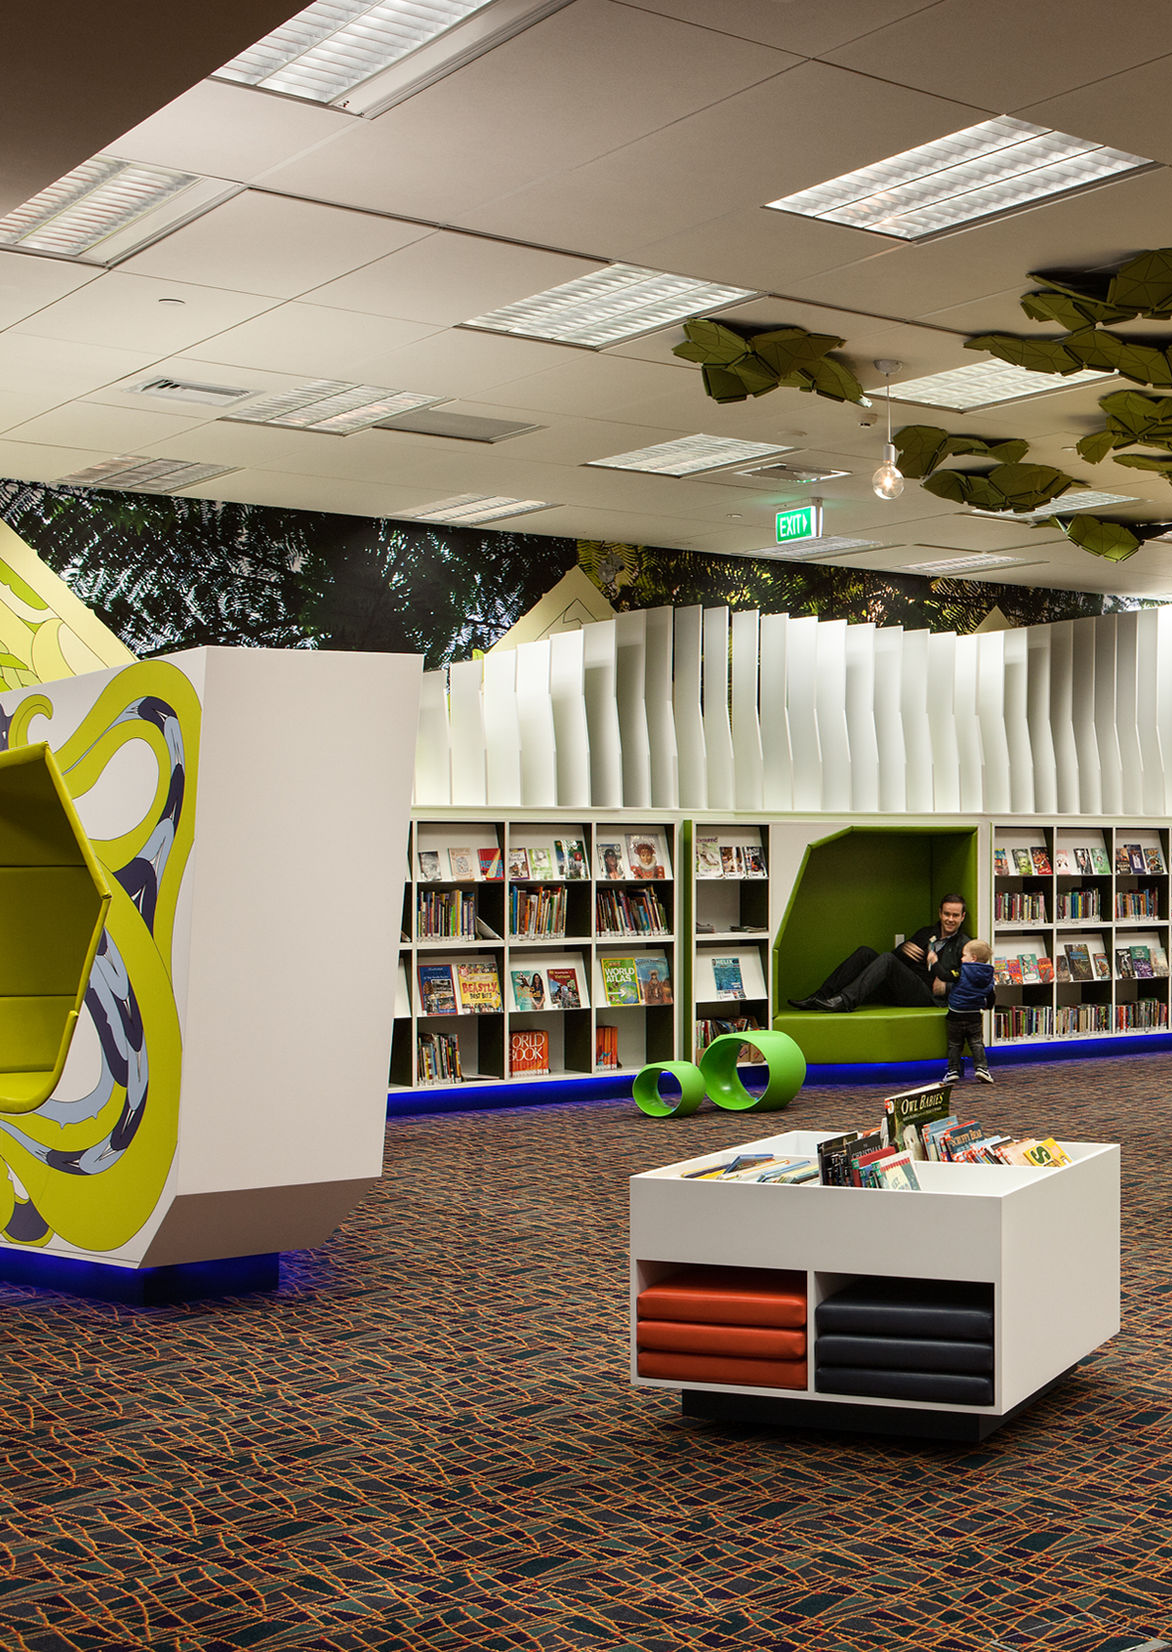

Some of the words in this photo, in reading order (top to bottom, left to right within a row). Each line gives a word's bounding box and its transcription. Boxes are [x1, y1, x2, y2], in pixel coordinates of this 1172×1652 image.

[780, 514, 802, 537] EXIT
[605, 967, 635, 976] WORLD
[606, 975, 632, 983] ATLAS
[462, 982, 498, 994] BEASTLY
[919, 1092, 945, 1110] BABIES
